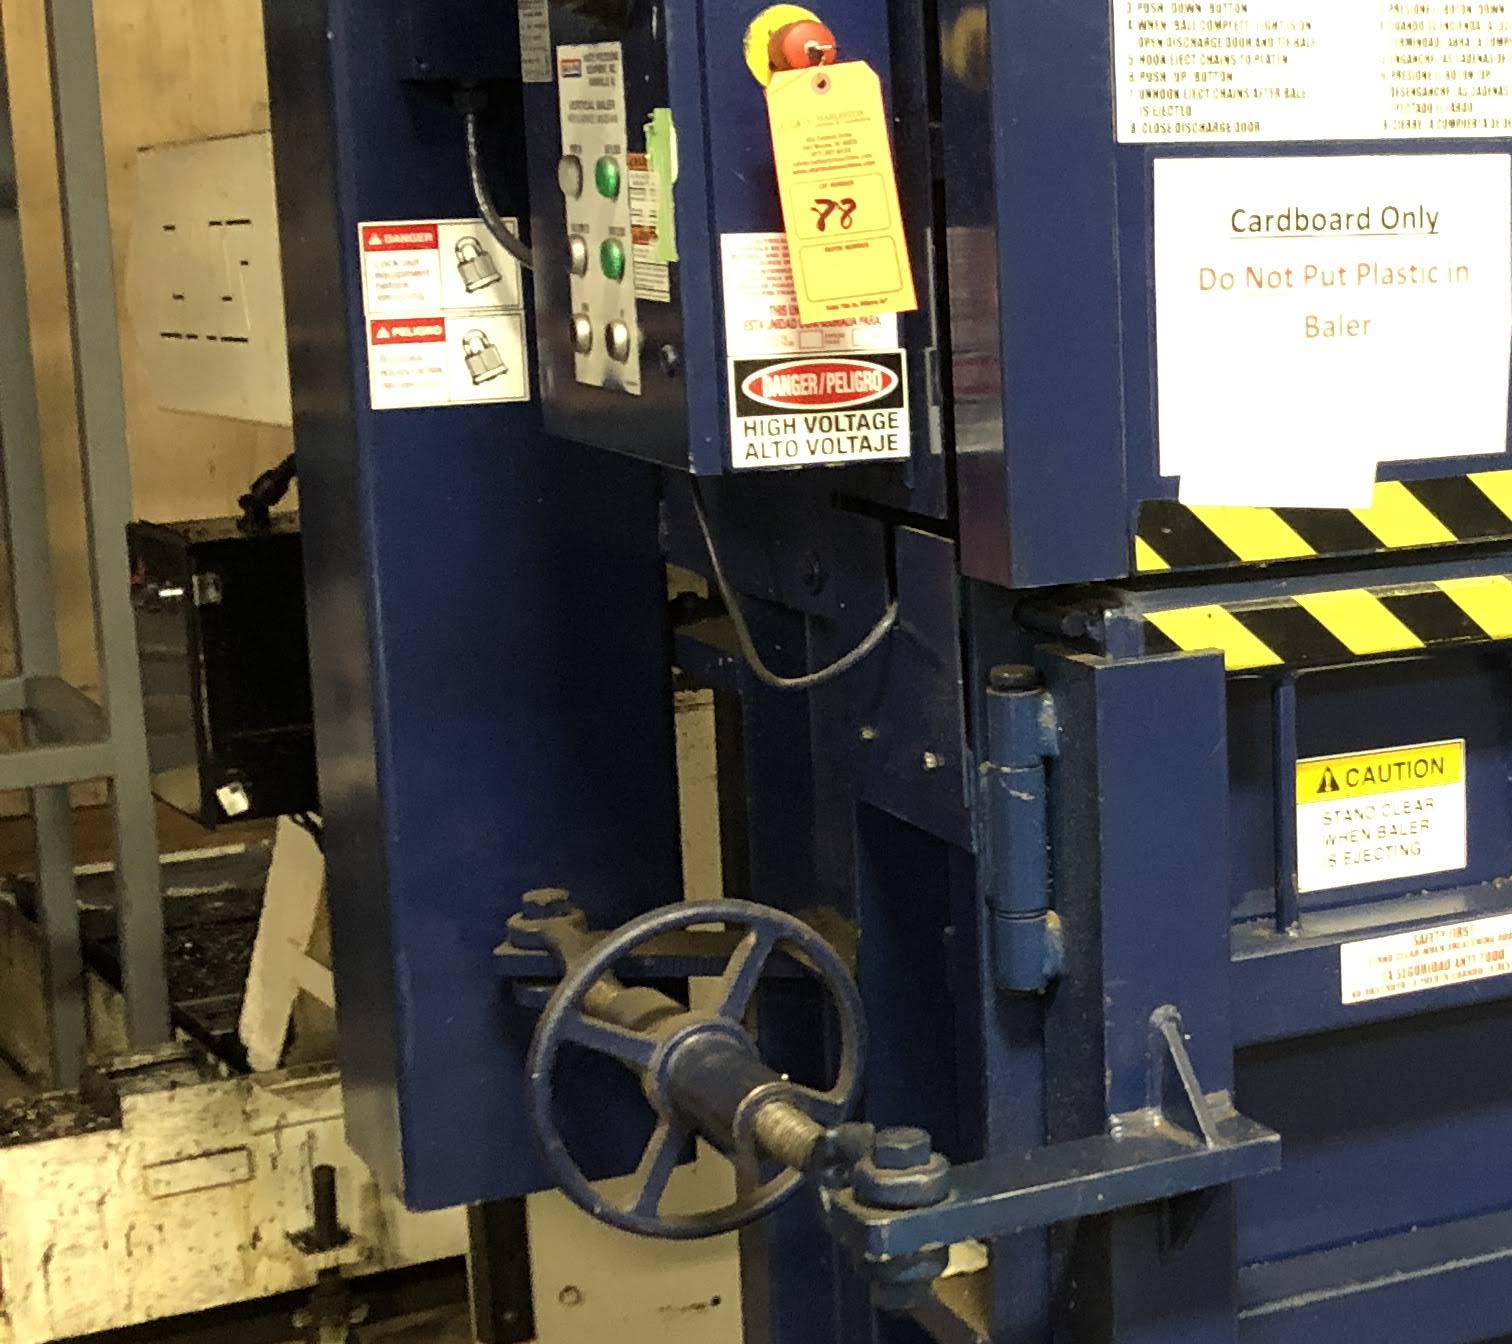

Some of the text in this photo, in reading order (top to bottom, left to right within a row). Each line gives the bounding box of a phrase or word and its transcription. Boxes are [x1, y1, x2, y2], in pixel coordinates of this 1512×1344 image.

[1137, 3, 1164, 13] PUSH
[1138, 20, 1167, 30] WHEN
[1138, 38, 1163, 48] OPEN
[1166, 37, 1222, 48] DISCHARGE
[1225, 37, 1252, 48] DOOR
[1255, 37, 1274, 48] AND
[1139, 55, 1166, 65] HOOK
[1200, 55, 1237, 65] CHAINS
[1139, 72, 1167, 82] PUSH
[1139, 89, 1180, 99] UNHOOK
[1213, 89, 1250, 99] CHAINS
[1152, 105, 1192, 116] EJECTED
[1141, 122, 1261, 133] CLOSE DISCHARGE DOOR
[1231, 205, 1440, 235] Cardboard Only
[383, 232, 433, 246] DANGER
[1199, 262, 1469, 290] Do Not Put Plastic in
[390, 325, 443, 339] PELIGRO
[1305, 314, 1371, 338] Baler
[762, 370, 883, 398] DANGER/PELIGRO
[744, 412, 899, 437] HIGH VOLTAGE
[745, 434, 898, 460] ALTO VOLTAJE
[1346, 757, 1443, 787] CAUTION
[1323, 798, 1434, 826] STAND CLEAR
[1325, 819, 1430, 846] WHEN BALER
[1344, 841, 1421, 865] EJECTING
